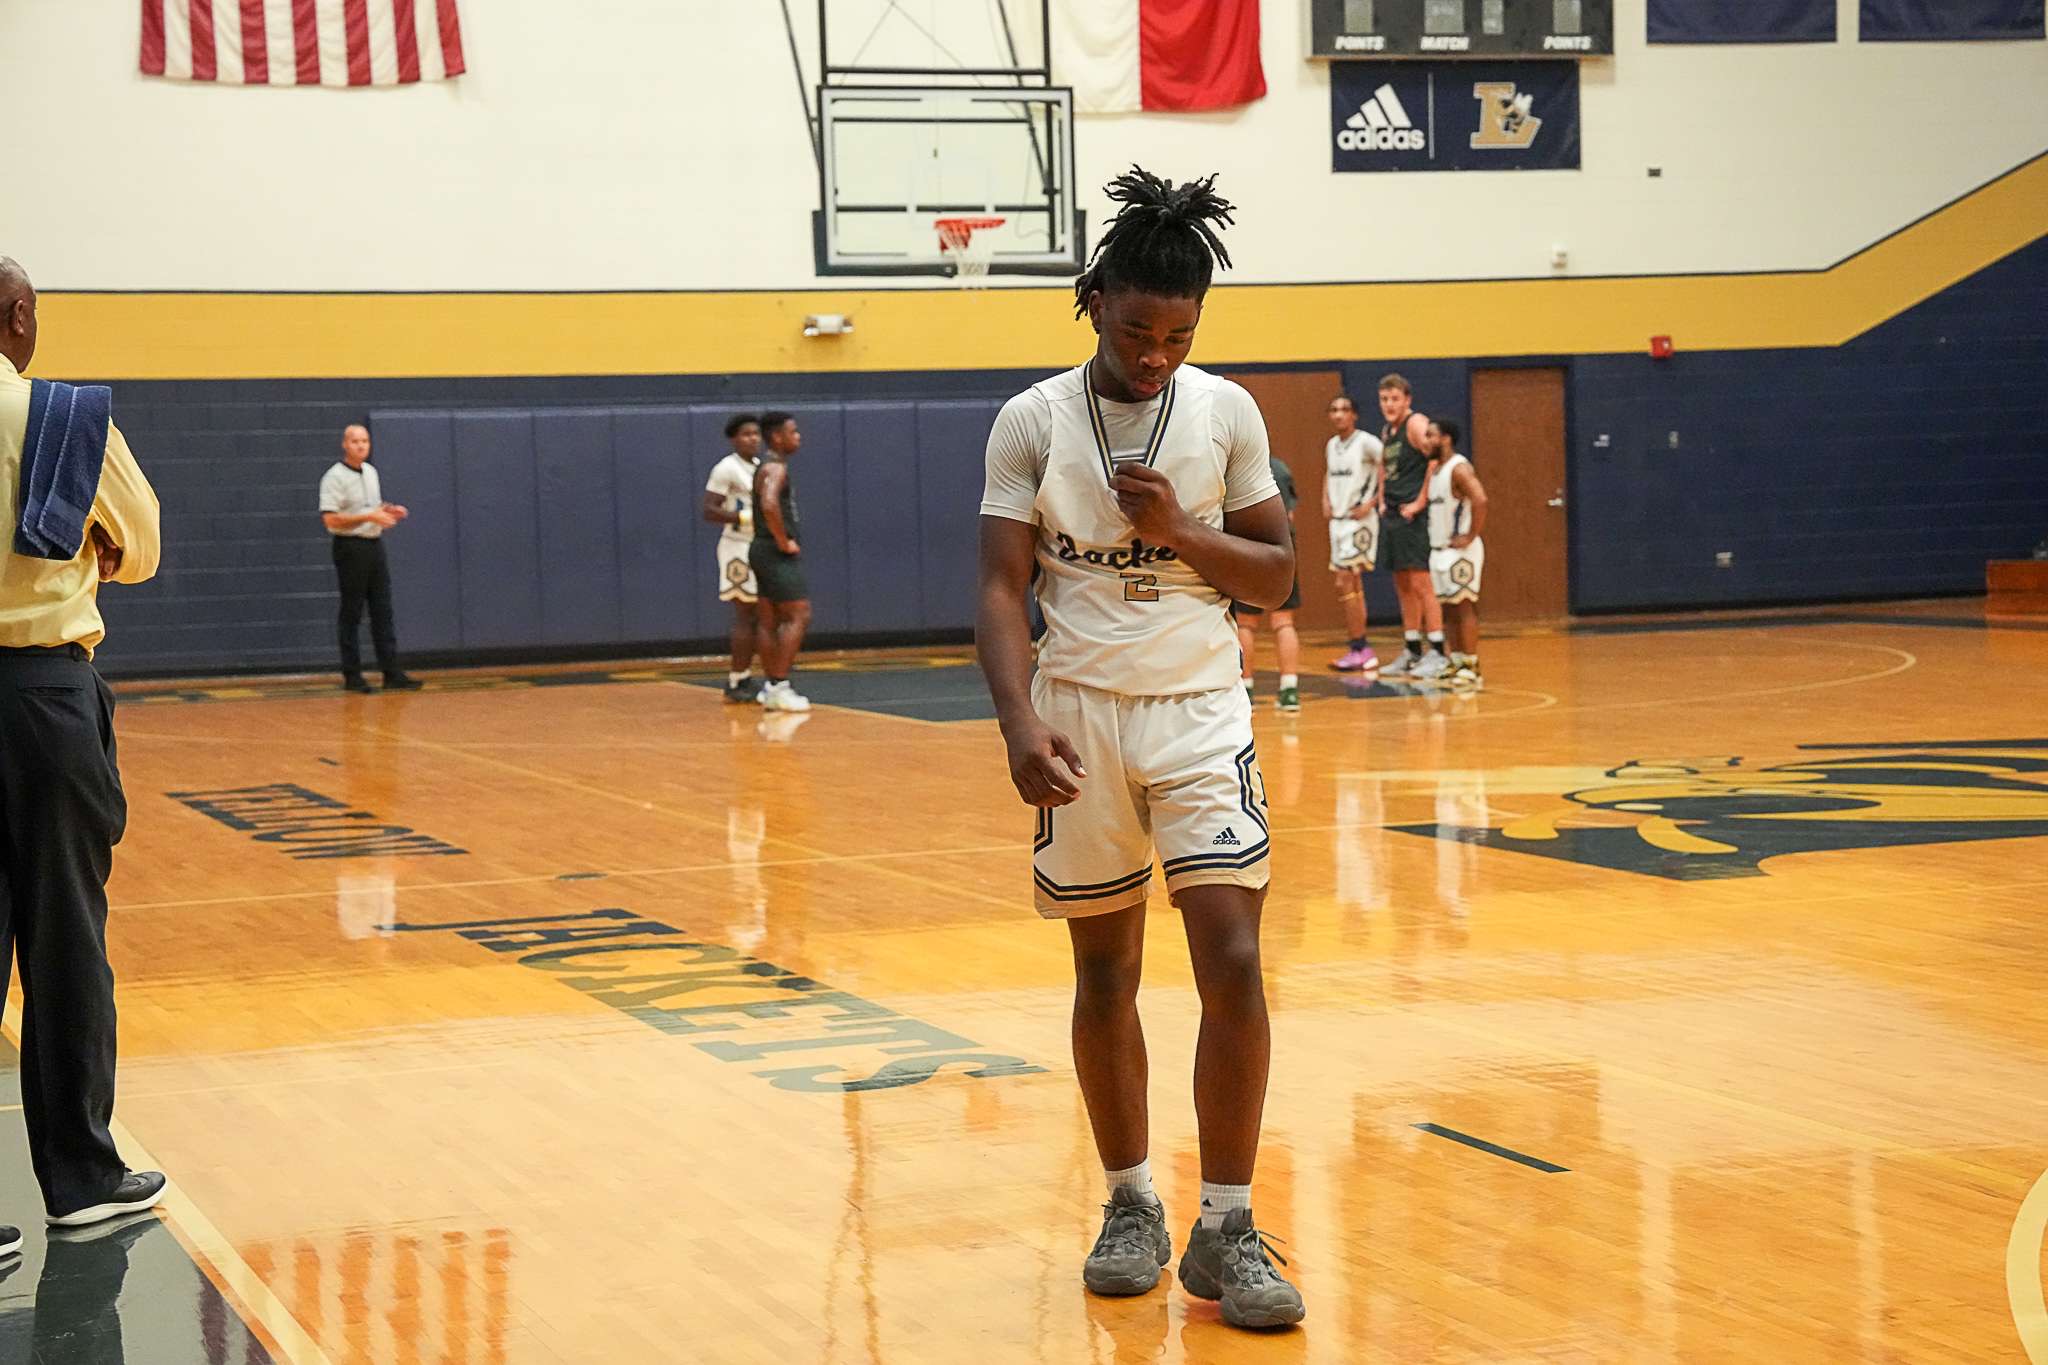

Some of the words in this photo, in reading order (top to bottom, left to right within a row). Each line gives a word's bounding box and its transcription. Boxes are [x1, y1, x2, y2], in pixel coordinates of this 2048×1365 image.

[1335, 35, 1385, 51] POINTS
[1543, 35, 1592, 51] POINTS
[1337, 126, 1425, 150] adidas
[1056, 530, 1178, 570] Jacke
[1120, 572, 1159, 601] 2
[1212, 837, 1241, 846] adidas
[372, 907, 1051, 1094] JACKETS
